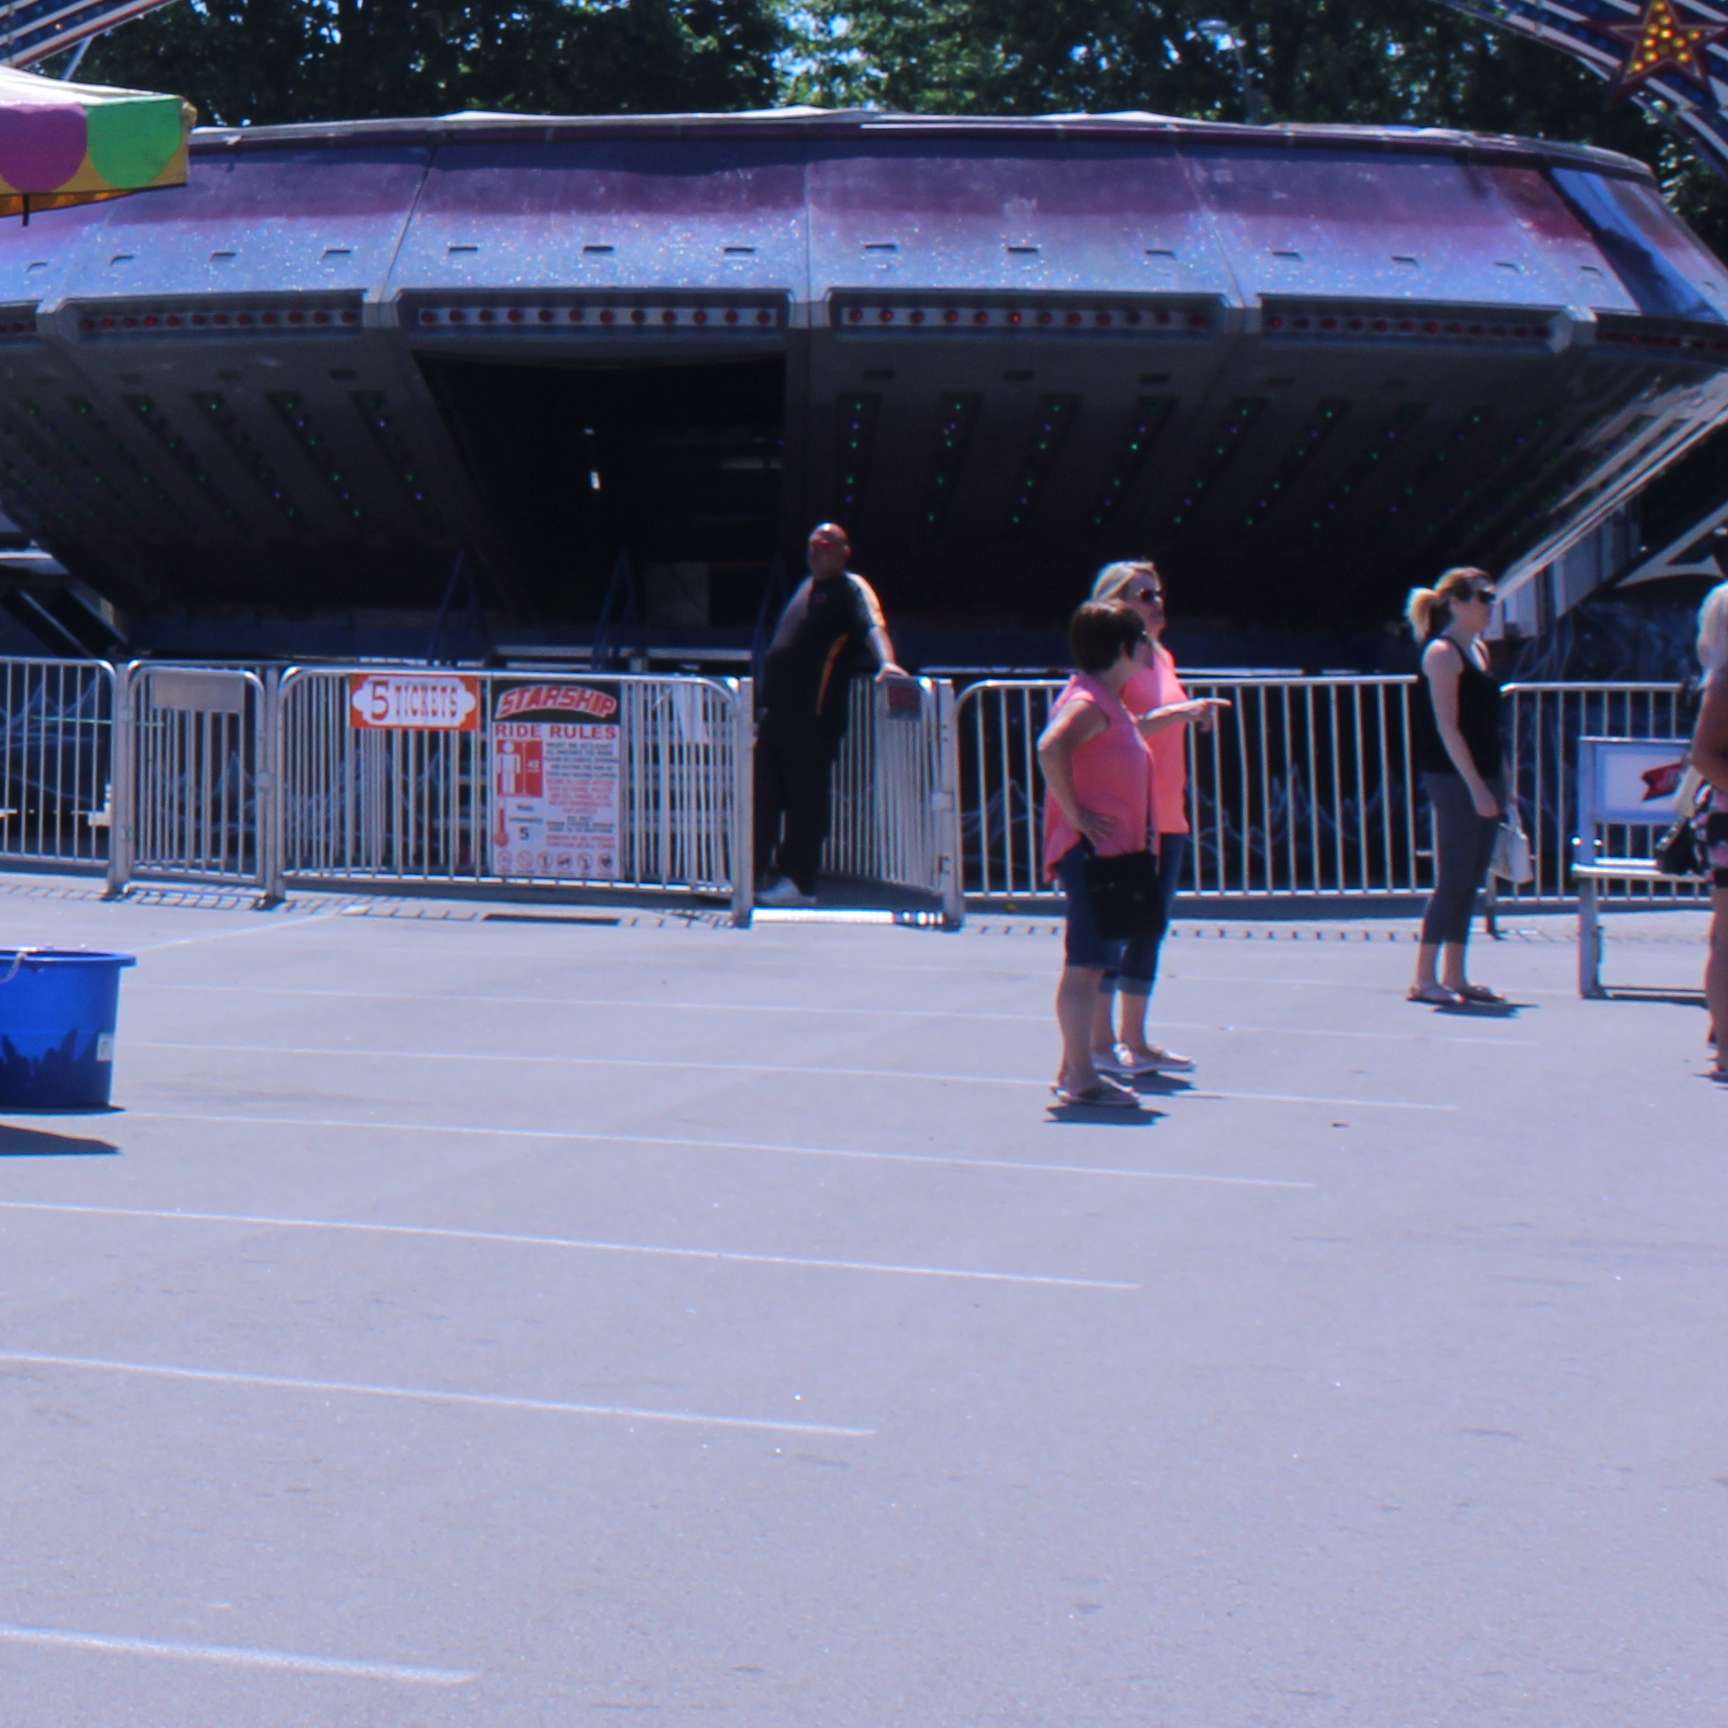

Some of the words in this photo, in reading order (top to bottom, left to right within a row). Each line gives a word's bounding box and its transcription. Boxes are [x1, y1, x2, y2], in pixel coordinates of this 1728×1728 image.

[371, 680, 390, 721] 5
[395, 685, 458, 718] TICKETS
[495, 683, 617, 720] STARSHIP
[495, 724, 542, 738] RIDE
[549, 725, 617, 740] RULES
